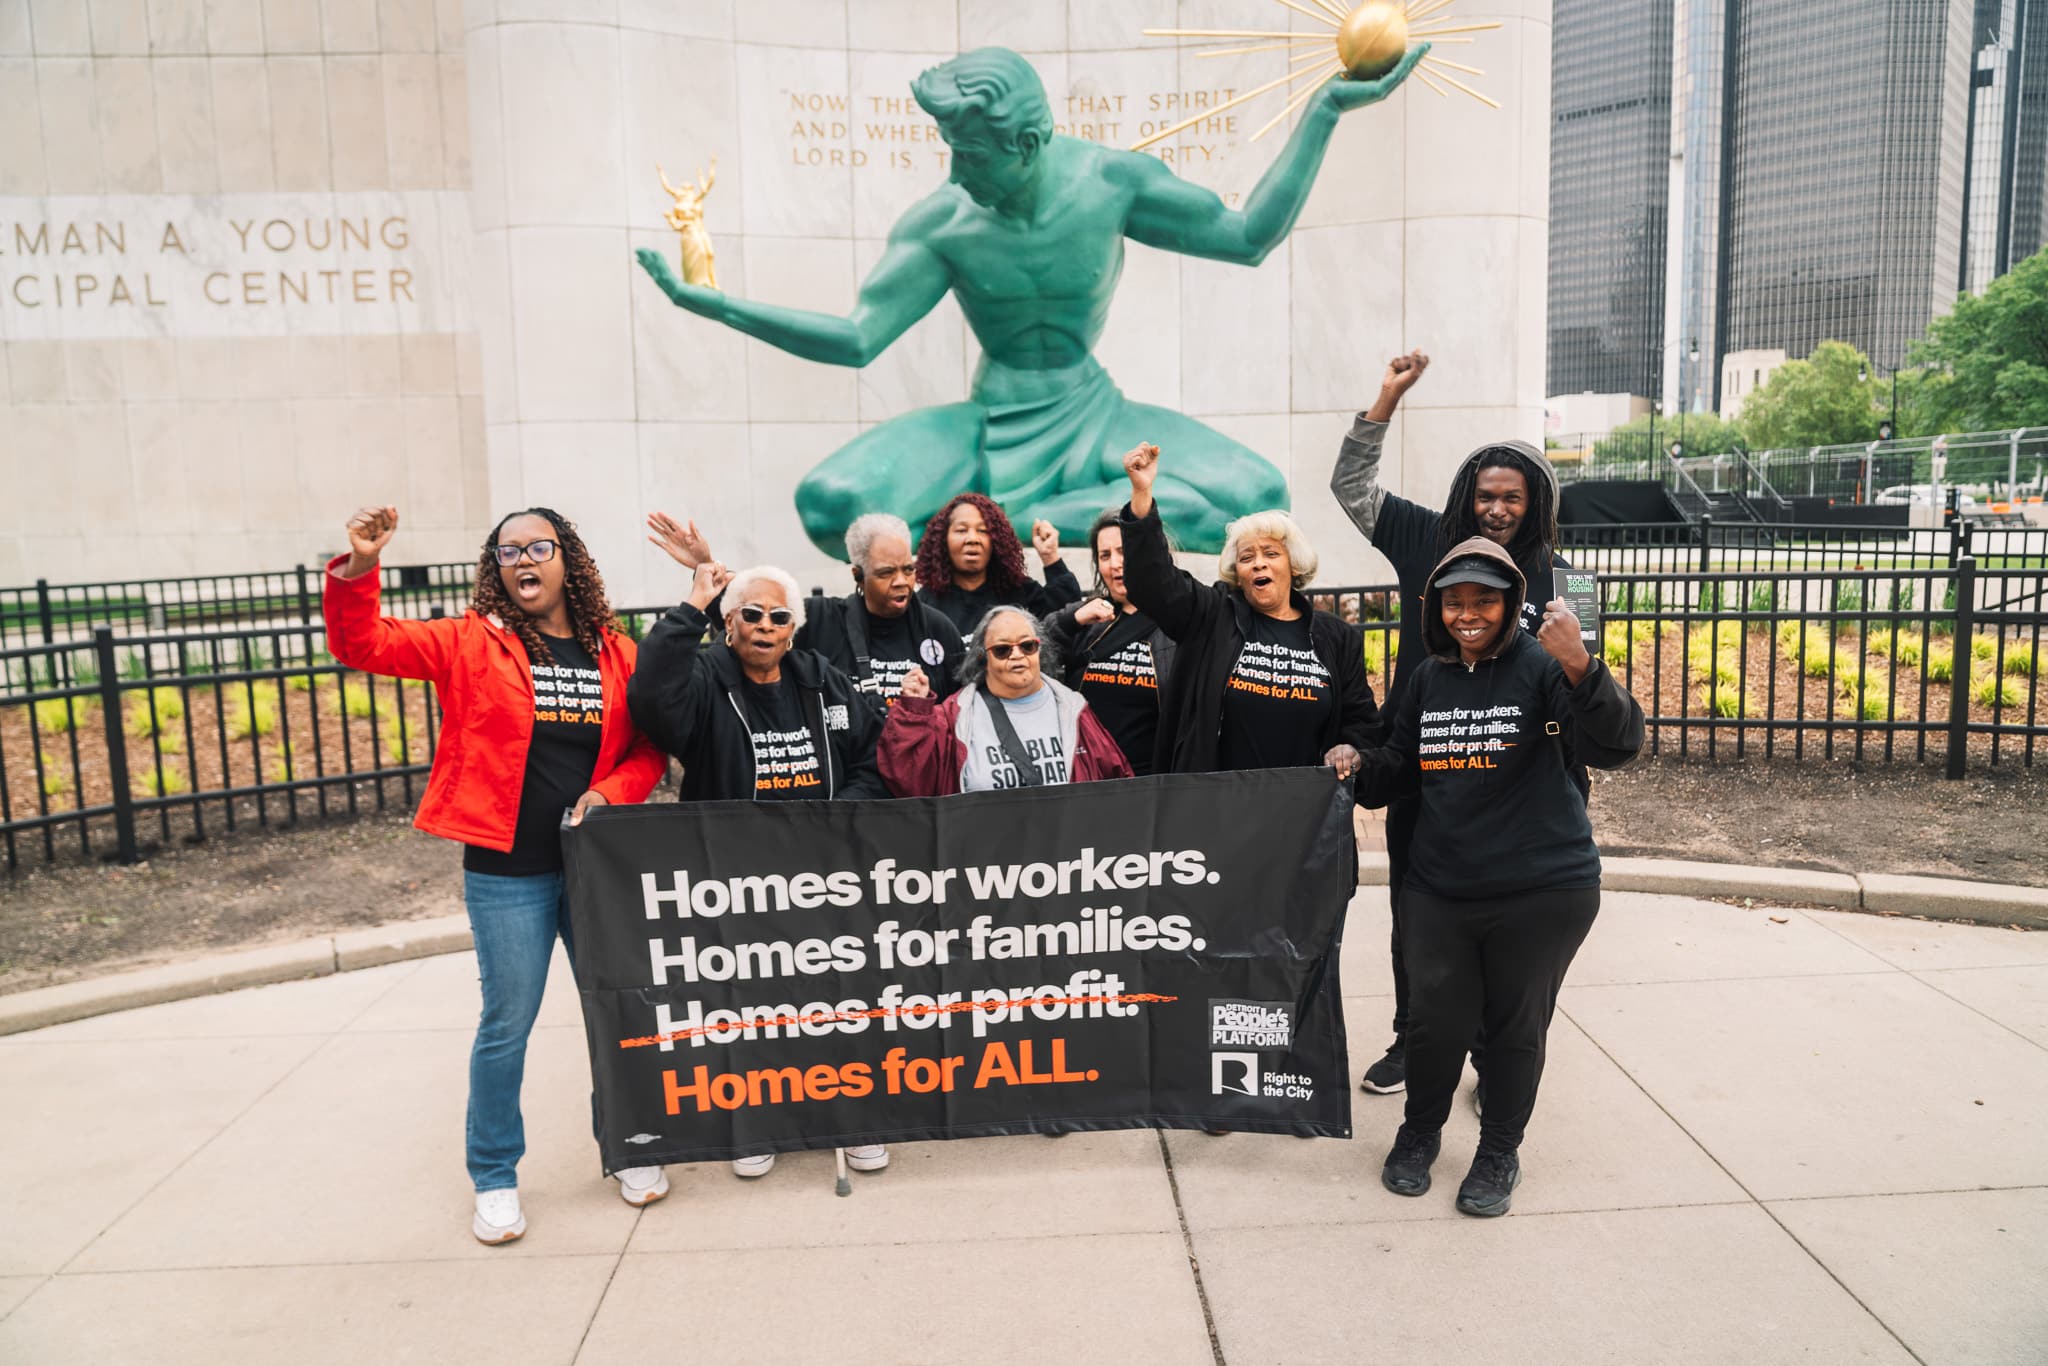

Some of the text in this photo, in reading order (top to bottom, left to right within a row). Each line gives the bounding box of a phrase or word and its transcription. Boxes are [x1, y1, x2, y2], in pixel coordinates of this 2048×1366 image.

[867, 96, 916, 115] THE
[1064, 95, 1126, 114] THAT
[1149, 88, 1237, 112] SPIRIT
[791, 121, 847, 140] AND
[1139, 120, 1170, 138] OF
[1190, 116, 1238, 136] THE
[793, 147, 868, 167] LORD
[0, 221, 126, 256] MAN
[229, 217, 409, 253] YOUNG
[203, 269, 414, 305] CENTER
[1522, 602, 1537, 616] rs.
[1272, 643, 1288, 656] for
[553, 660, 573, 678] for
[1119, 661, 1136, 673] for
[1272, 657, 1291, 670] for
[1117, 673, 1134, 686] for
[1272, 671, 1290, 684] for
[555, 680, 576, 693] for
[1227, 675, 1318, 701] Homes for ALL.
[557, 694, 579, 707] for
[559, 709, 581, 723] for
[1452, 707, 1470, 720] for
[1471, 705, 1522, 720] workers.
[1449, 723, 1467, 736] for
[768, 745, 787, 758] for
[1447, 739, 1466, 753] for
[1466, 737, 1506, 756] profit.
[770, 760, 789, 774] for
[1448, 755, 1466, 769] for
[1467, 755, 1498, 769] ALL.
[772, 776, 792, 790] for
[793, 773, 821, 788] ALL.
[640, 847, 1221, 920] Homes for workers.
[648, 905, 1207, 985] Homes for families.
[654, 969, 1140, 1052] Homes for profit.
[1226, 1004, 1261, 1012] DETROIT
[1213, 1005, 1289, 1028] People's
[1213, 1031, 1289, 1046] PLATFORM
[661, 1038, 1099, 1115] Homes for ALL.
[1263, 1072, 1312, 1086] Right to
[1263, 1085, 1314, 1101] the City
